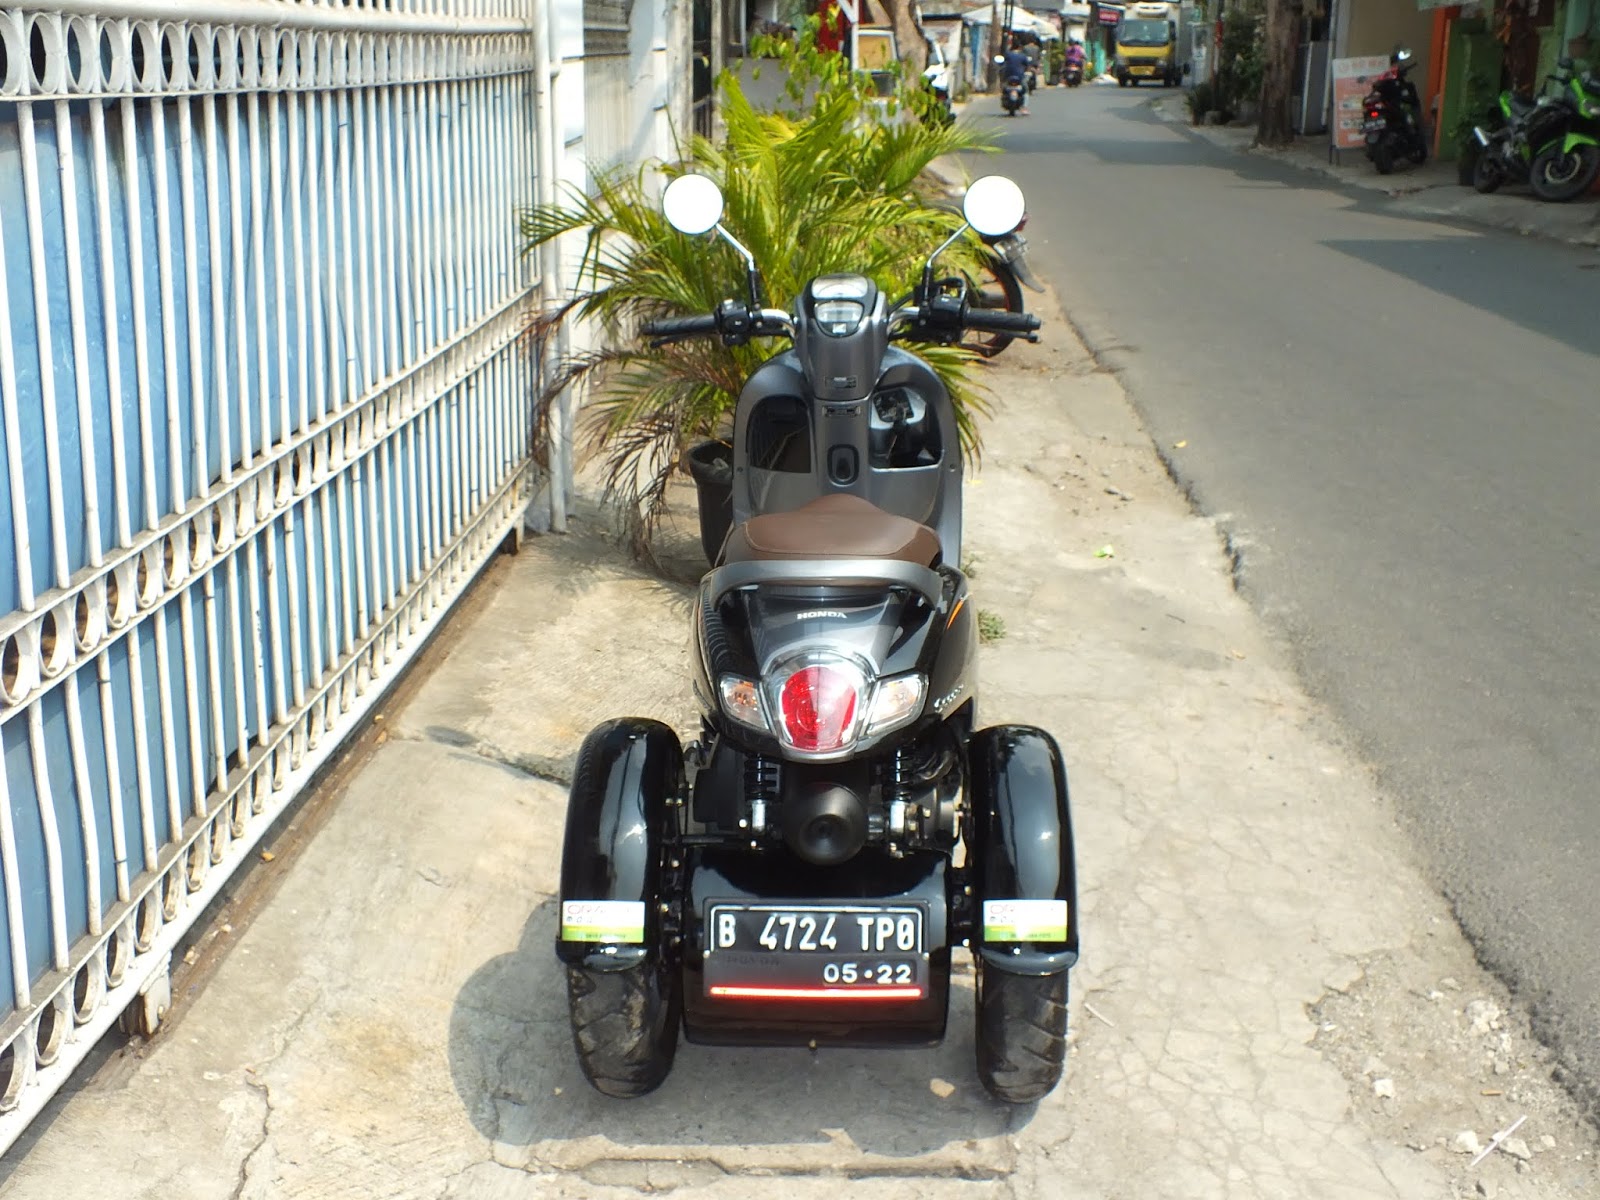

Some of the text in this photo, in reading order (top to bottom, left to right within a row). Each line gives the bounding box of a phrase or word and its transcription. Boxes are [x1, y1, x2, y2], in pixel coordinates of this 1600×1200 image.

[796, 610, 848, 620] HONDA
[718, 913, 737, 948] B
[759, 913, 837, 951] 4724
